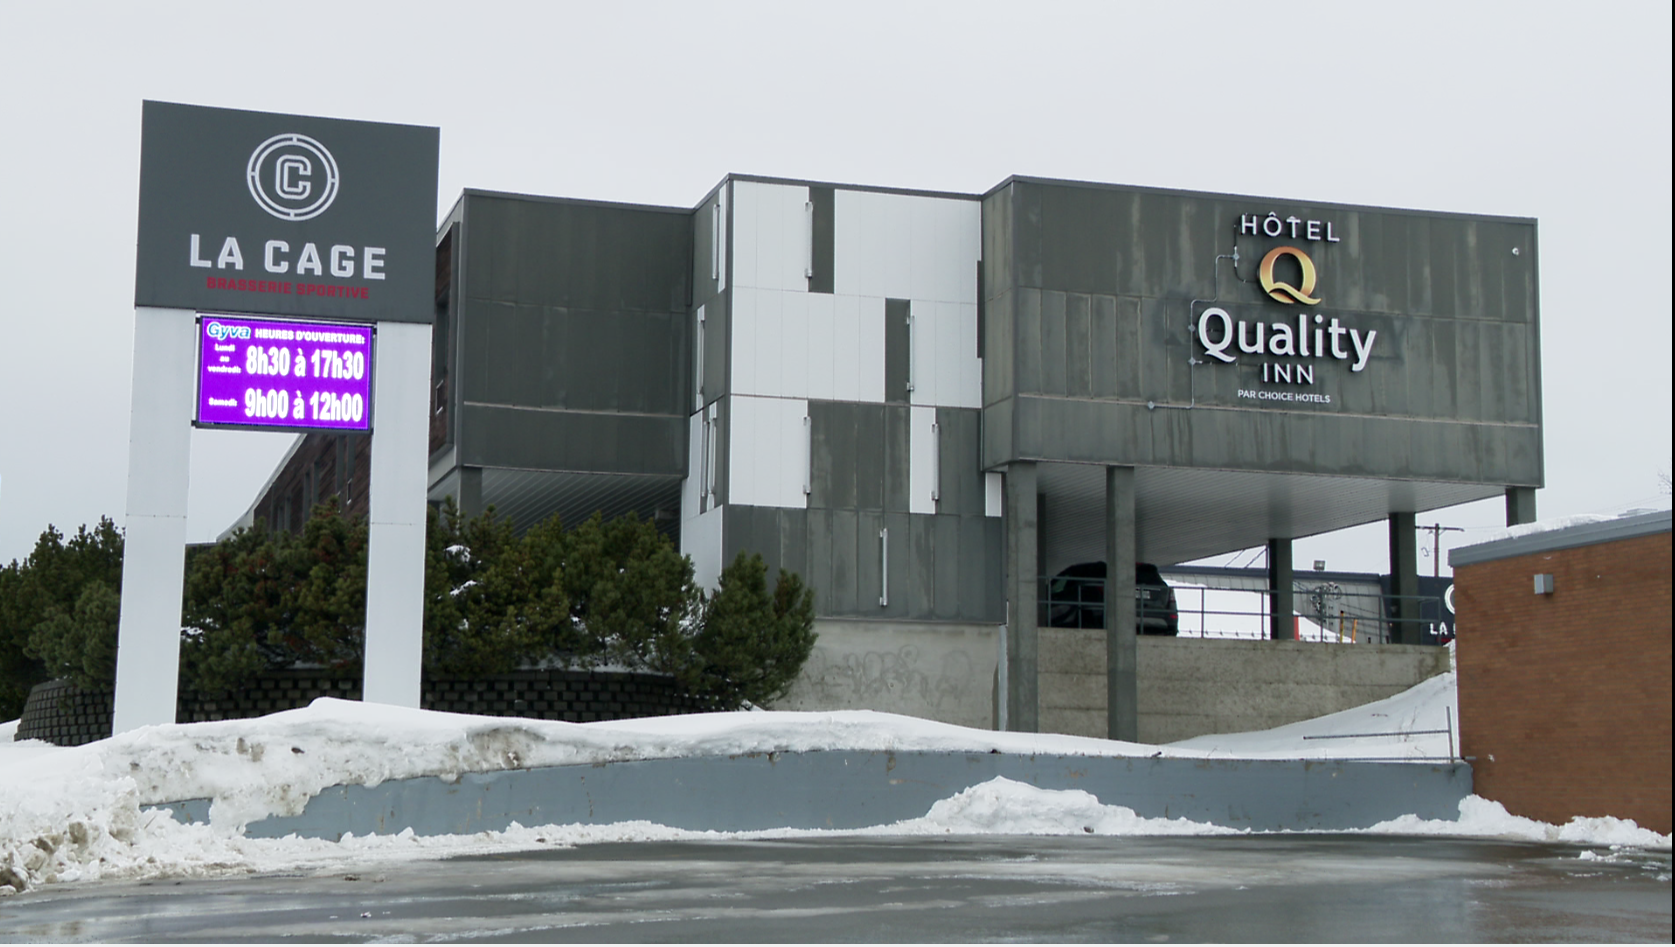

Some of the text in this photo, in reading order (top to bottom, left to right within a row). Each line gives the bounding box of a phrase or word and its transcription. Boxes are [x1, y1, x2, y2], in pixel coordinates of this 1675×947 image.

[275, 154, 312, 200] C
[1241, 211, 1340, 242] HÔTEL
[190, 234, 386, 280] LA CAGE
[1259, 246, 1322, 305] Q
[206, 276, 370, 300] BRASSERIE SPORTIVE
[207, 321, 366, 344] Gyva HEURES D'OUVERTURE:
[1198, 307, 1377, 372] Quality
[214, 343, 236, 352] Lundi
[219, 355, 230, 363] au
[207, 365, 242, 374] vendredi:
[246, 345, 365, 380] 8h30 à 17h30
[1262, 362, 1314, 385] INN
[208, 397, 238, 407] Samedi:
[244, 388, 364, 422] 9h00 à 12h00
[1237, 389, 1331, 403] PAR CHOICE HOTELS
[1429, 622, 1448, 636] LA
